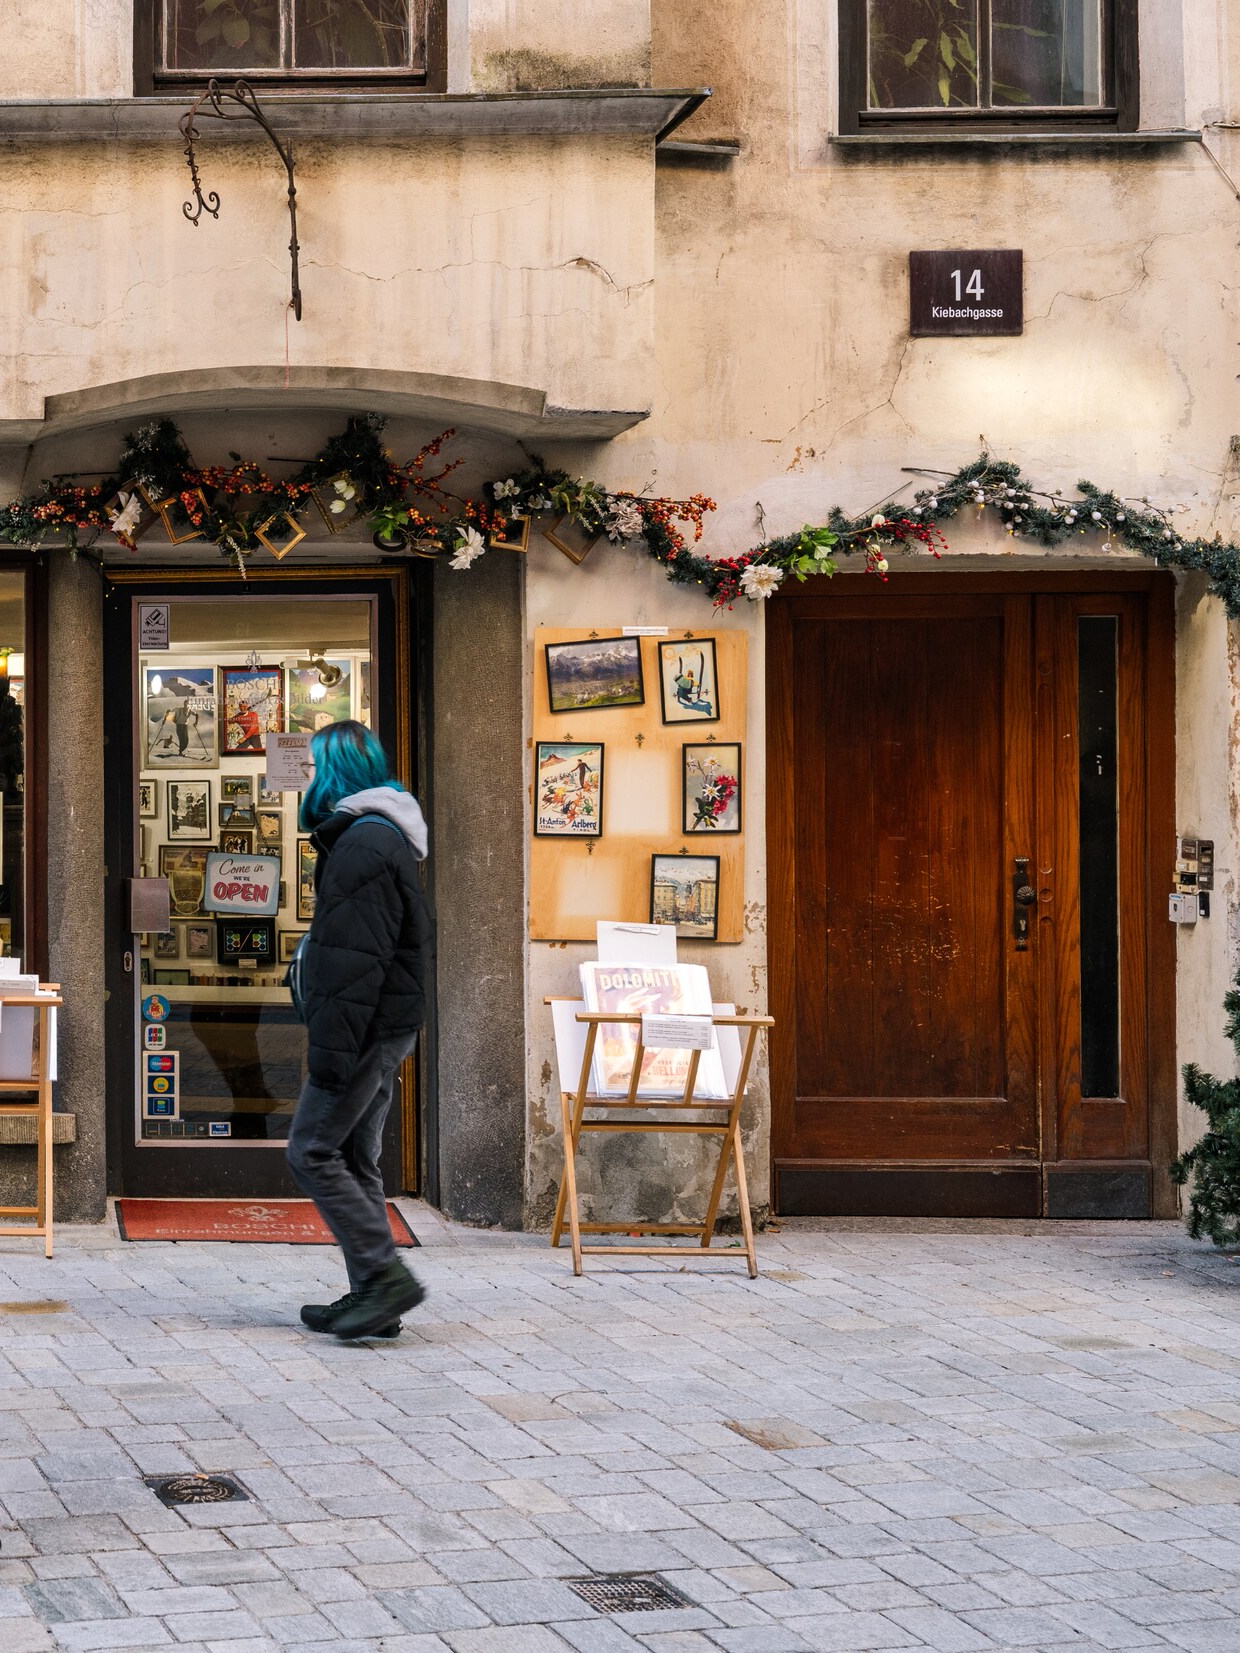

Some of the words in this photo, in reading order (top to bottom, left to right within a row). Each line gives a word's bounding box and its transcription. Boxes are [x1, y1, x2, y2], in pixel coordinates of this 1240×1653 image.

[950, 269, 985, 302] 14
[931, 306, 1004, 320] Kiebachgasse
[571, 819, 597, 830] Arlberg
[219, 858, 251, 875] Come
[253, 864, 264, 872] in
[213, 881, 269, 903] OPEN
